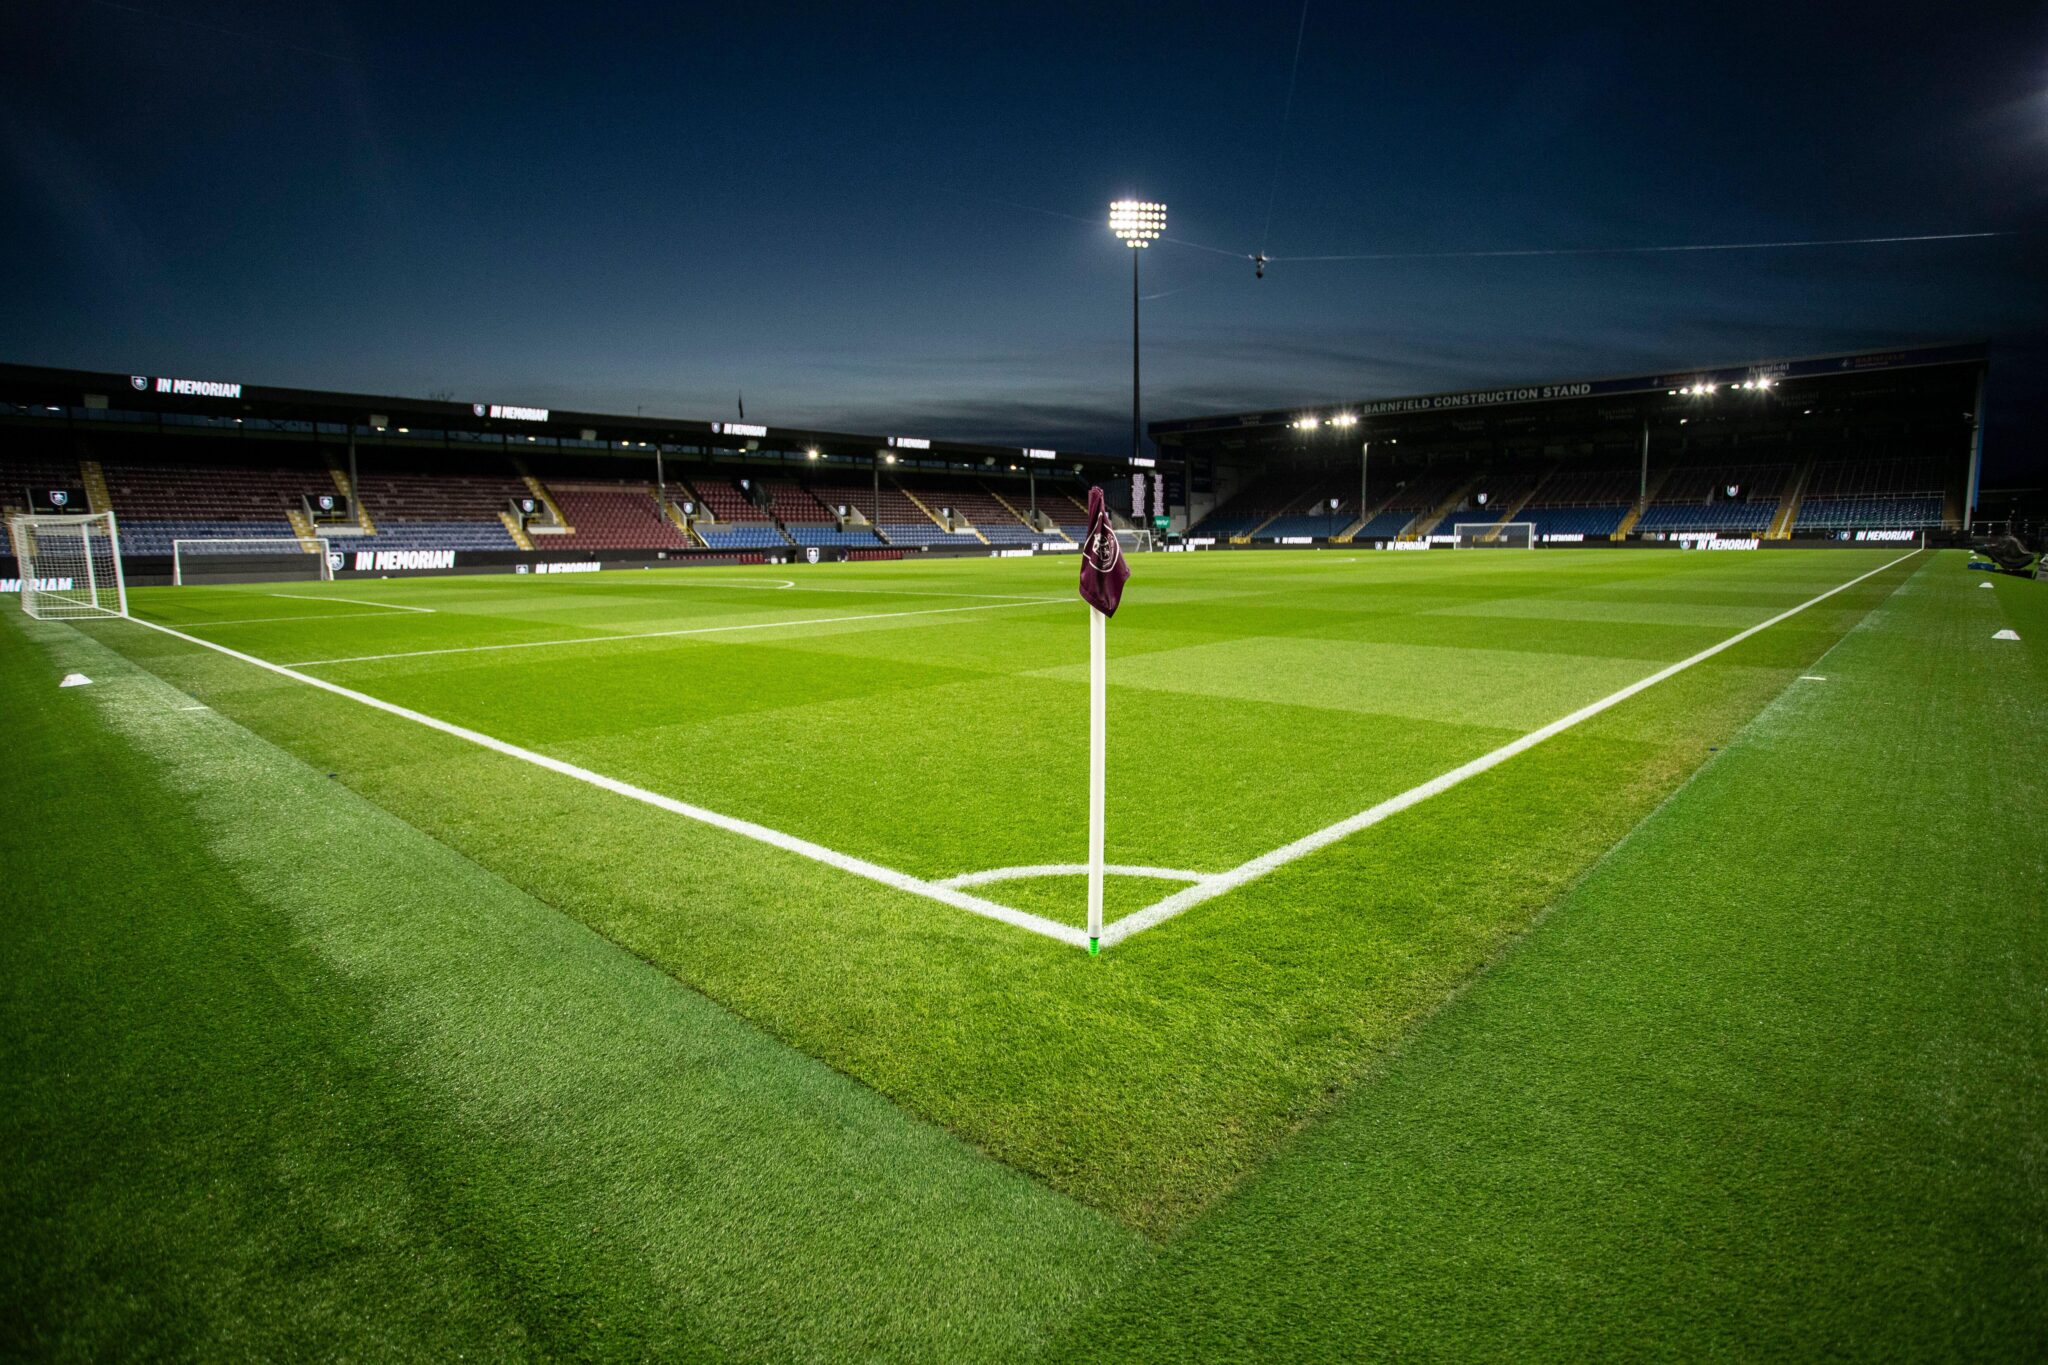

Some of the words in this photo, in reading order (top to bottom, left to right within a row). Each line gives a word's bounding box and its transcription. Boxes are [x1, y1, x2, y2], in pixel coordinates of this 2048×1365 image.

[156, 378, 172, 393] IN
[173, 379, 242, 398] MEMORIAM
[1364, 399, 1430, 414] BARNFIELD
[1434, 388, 1538, 407] CONSTRUCTION
[1543, 383, 1591, 398] STAND
[490, 405, 502, 418] IN
[502, 406, 549, 422] MEMORIAM
[1696, 539, 1708, 550] IN
[1708, 538, 1760, 550] MEMORIAM
[1855, 531, 1867, 541] IN
[1866, 530, 1915, 541] MEMORIAM
[355, 552, 374, 570] IN
[374, 550, 456, 570] MEMORIAM
[535, 563, 548, 574] IN
[548, 562, 601, 573] MEMORIAM
